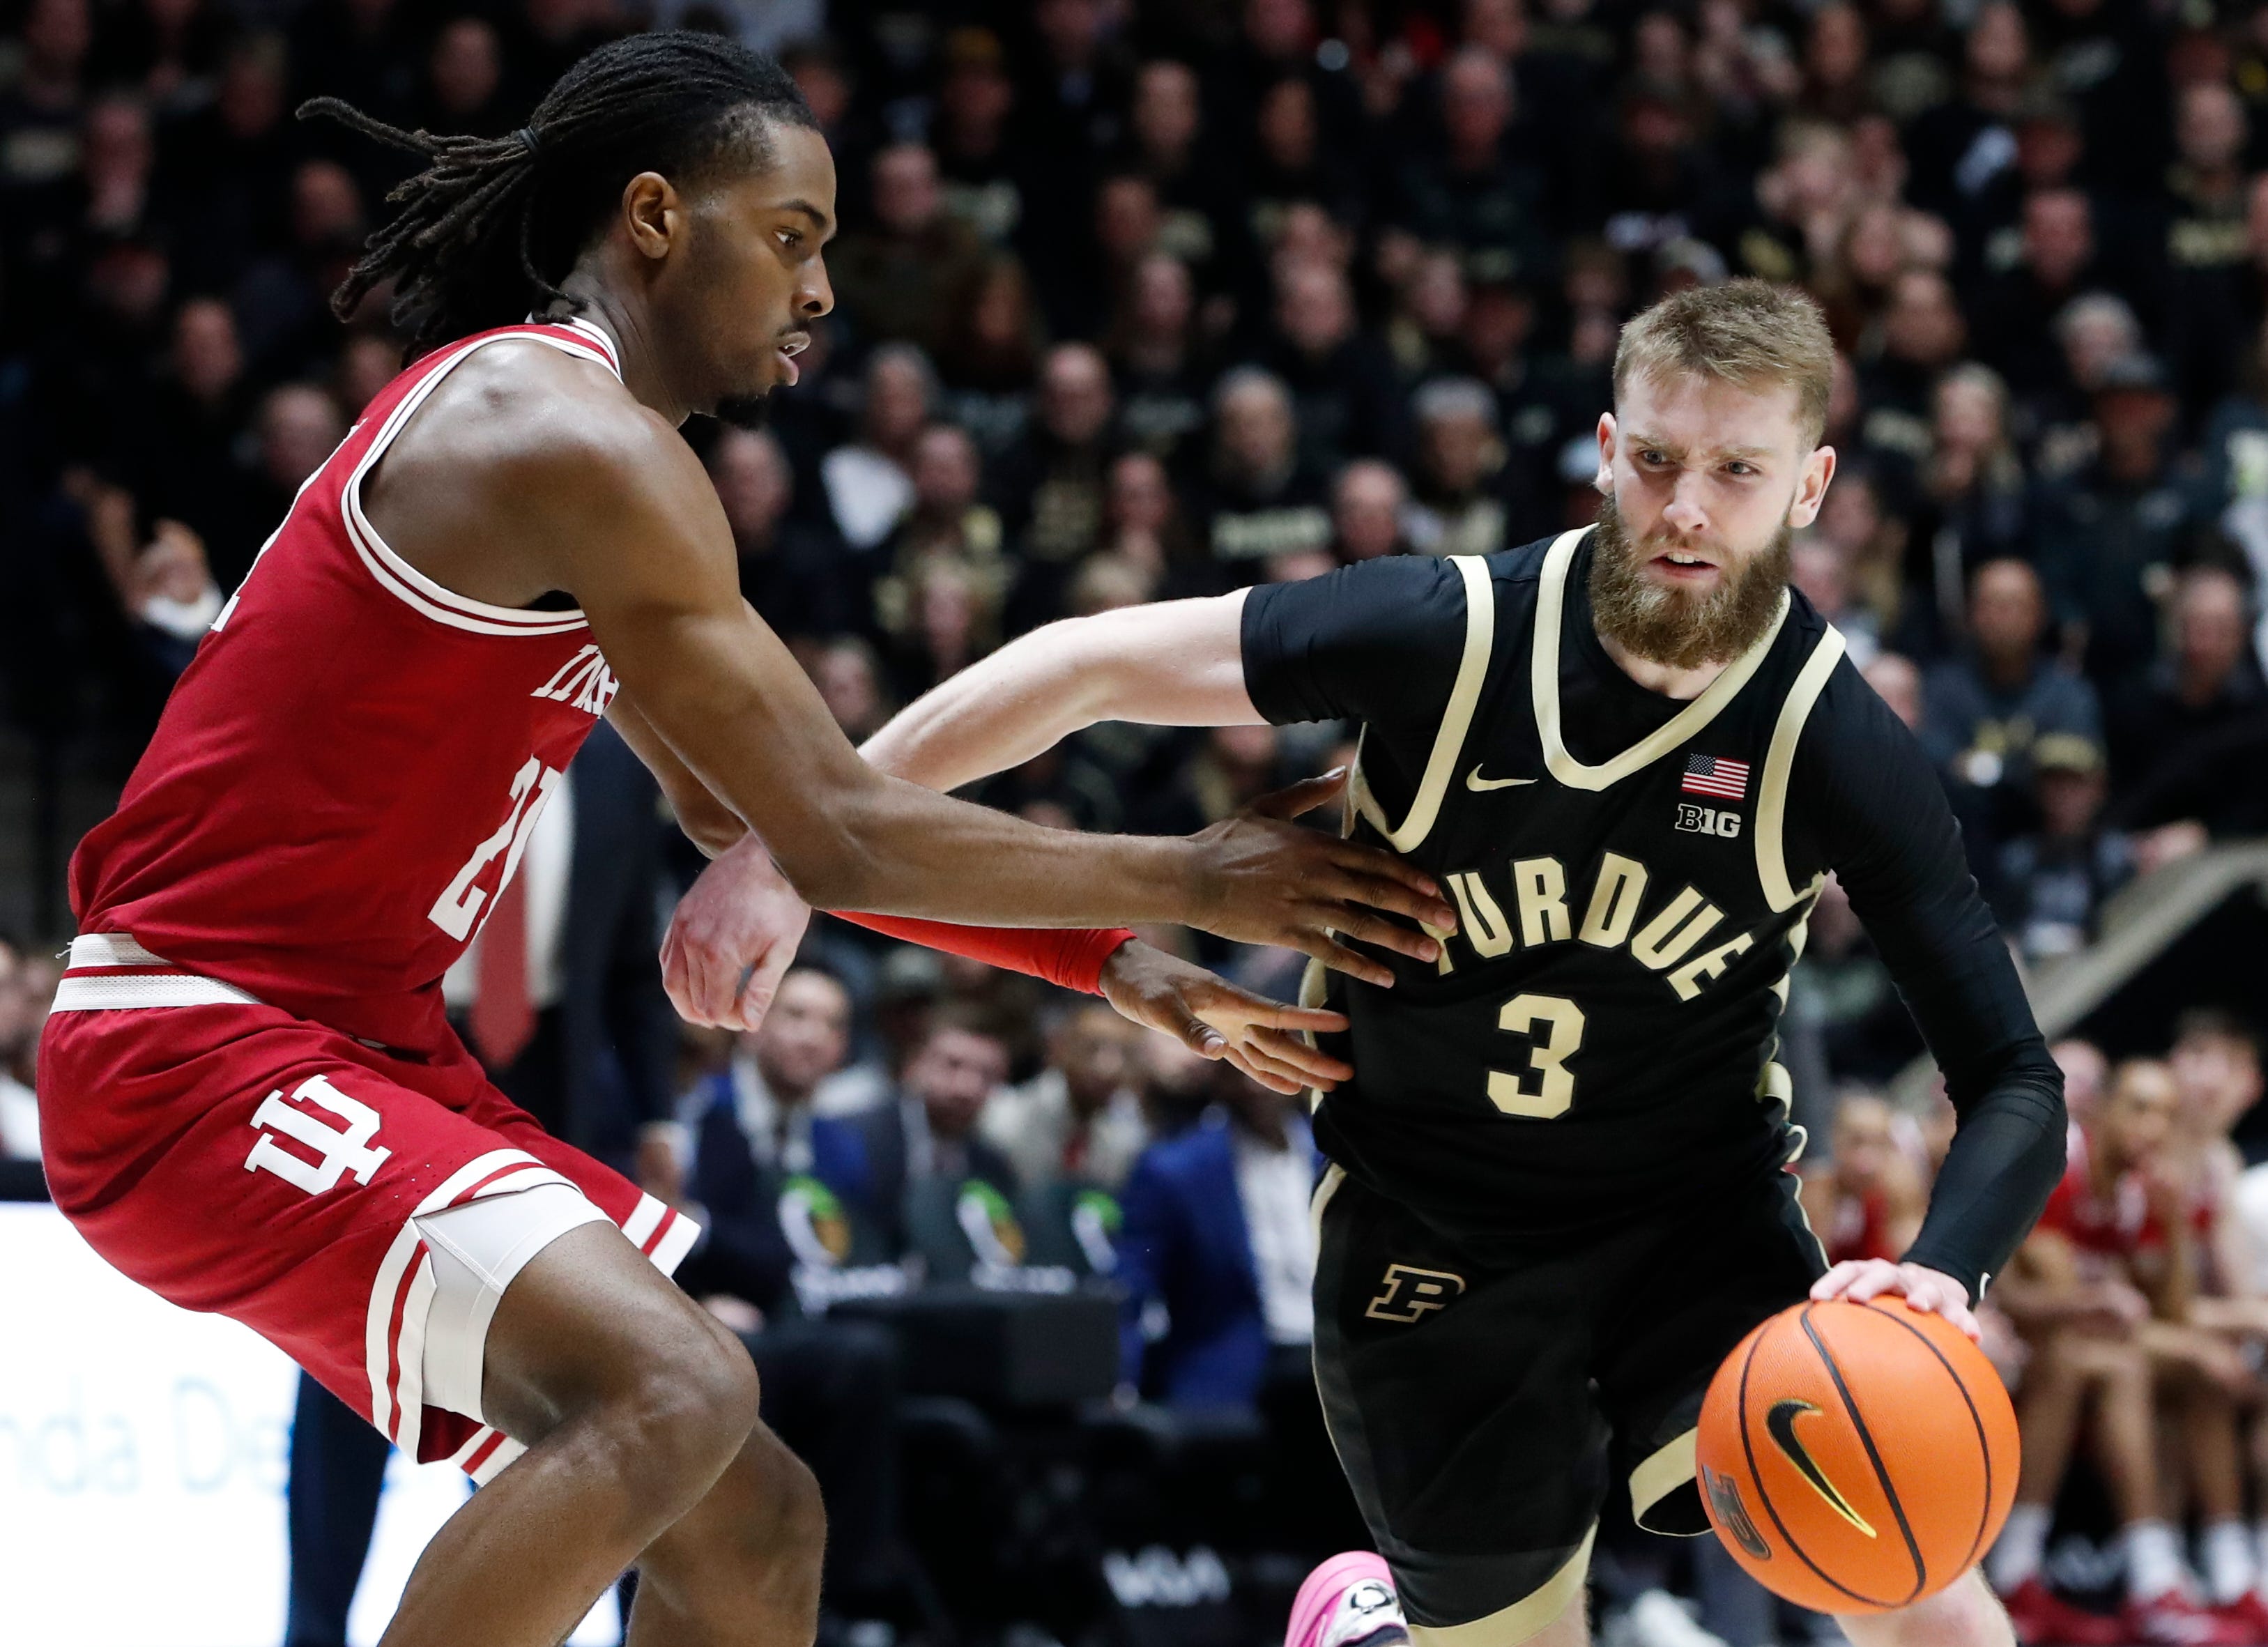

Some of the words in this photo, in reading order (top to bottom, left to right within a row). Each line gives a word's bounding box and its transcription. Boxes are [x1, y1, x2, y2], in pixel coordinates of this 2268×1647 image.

[427, 753, 562, 946] 21
[1487, 993, 1586, 1119] 3
[1365, 1263, 1466, 1323] P
